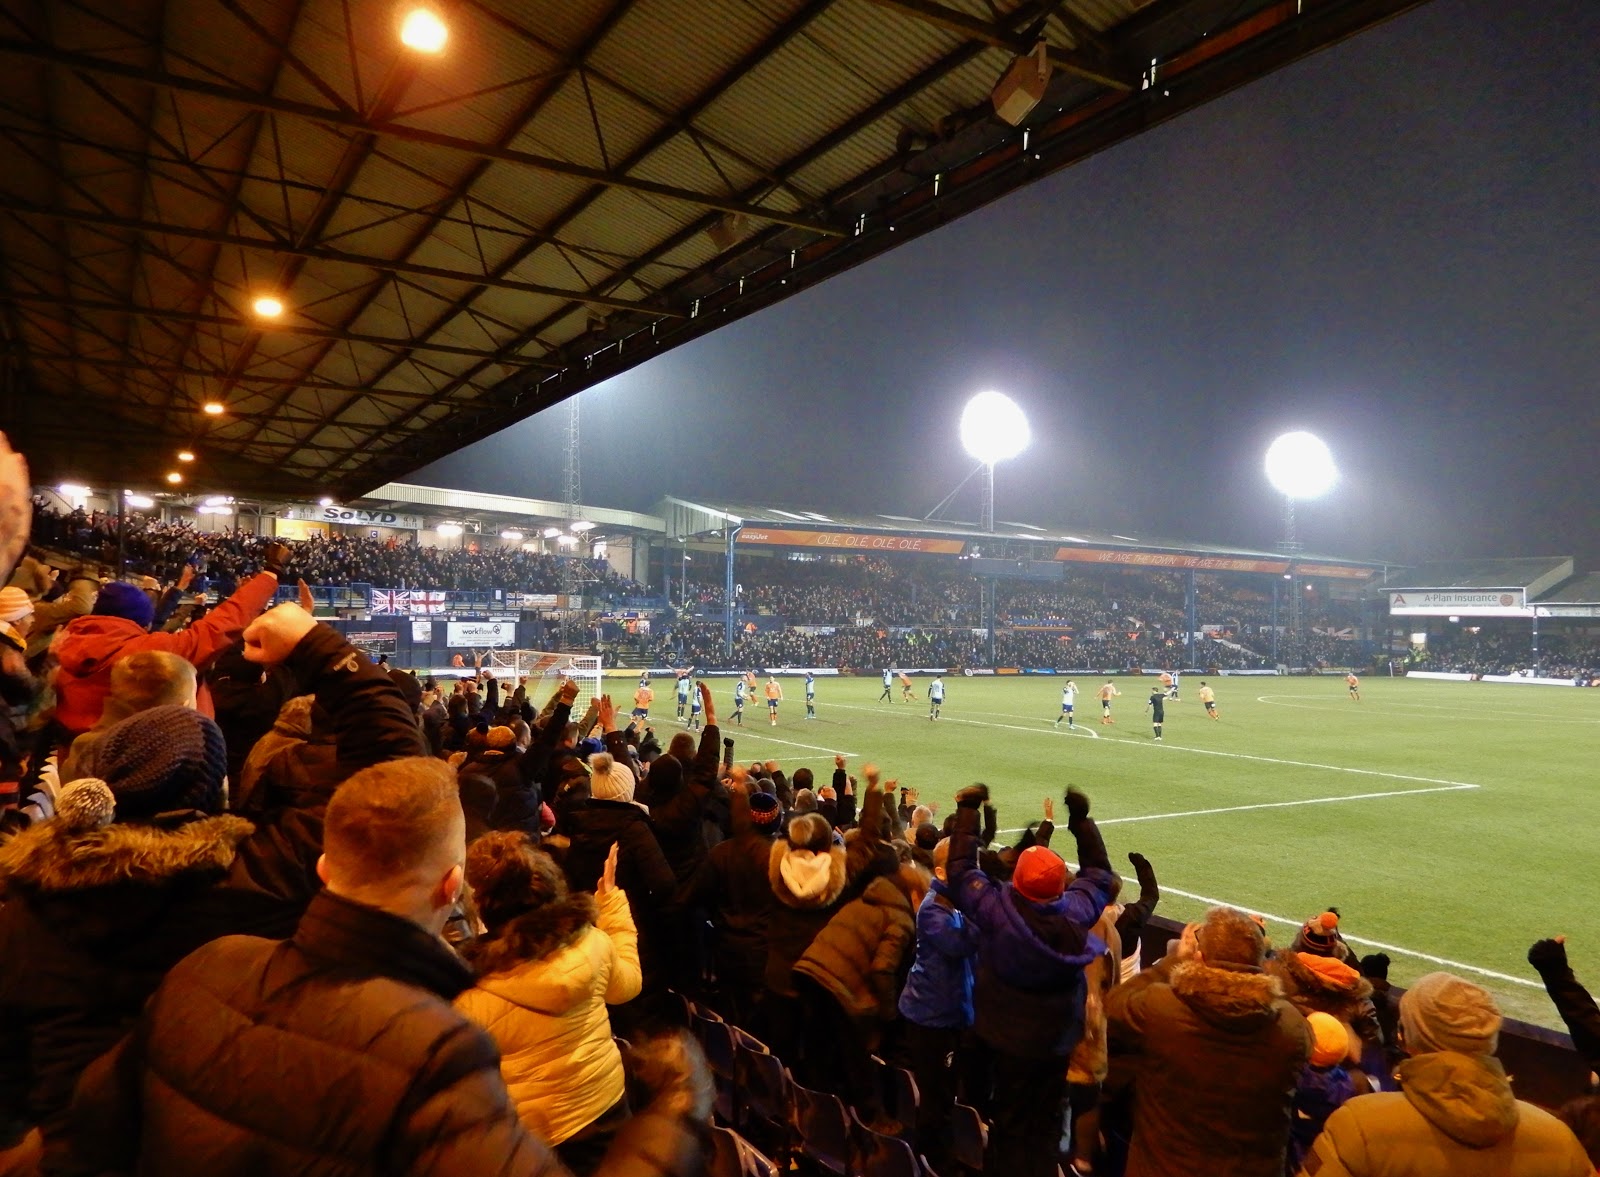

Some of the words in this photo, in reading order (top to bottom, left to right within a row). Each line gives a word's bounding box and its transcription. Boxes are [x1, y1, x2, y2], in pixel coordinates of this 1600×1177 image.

[741, 533, 769, 541] easyJet
[1098, 552, 1114, 561] WE
[1113, 553, 1133, 562] ARE
[1133, 554, 1151, 563] THE
[1151, 555, 1178, 565] TOWN
[1183, 558, 1199, 566] WE
[1197, 559, 1215, 567] ARE
[1215, 559, 1231, 568] THE
[1454, 593, 1498, 602] Insurance
[462, 627, 493, 635] workflow
